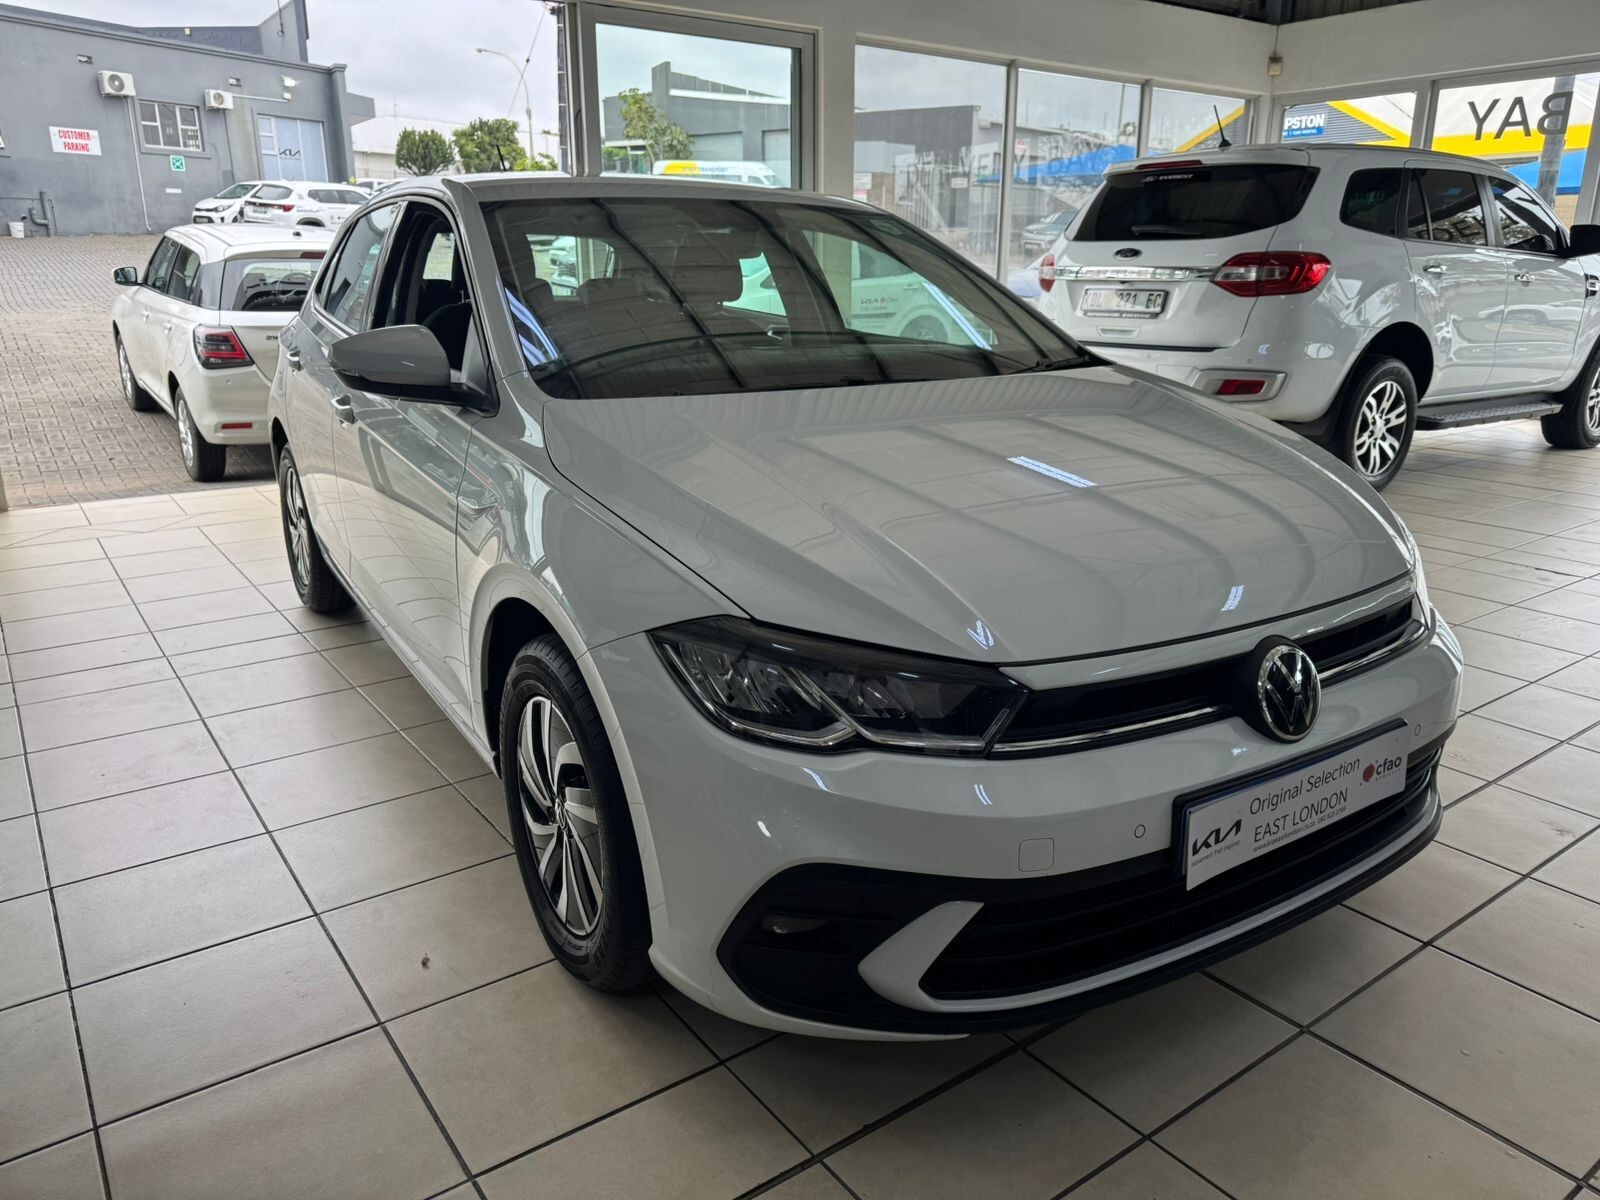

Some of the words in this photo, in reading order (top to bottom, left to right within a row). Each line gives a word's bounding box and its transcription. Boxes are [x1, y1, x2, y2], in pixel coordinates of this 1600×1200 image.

[58, 129, 91, 141] CUSTOMER
[63, 141, 90, 152] PARKING
[1115, 292, 1138, 308] 271
[1145, 293, 1162, 309] EC
[1376, 757, 1402, 776] cfao
[1250, 780, 1302, 815] Original
[1306, 758, 1361, 793] Selection
[1254, 814, 1289, 843] EAST
[1292, 787, 1348, 827] LONDON
[1192, 819, 1242, 856] KIA
